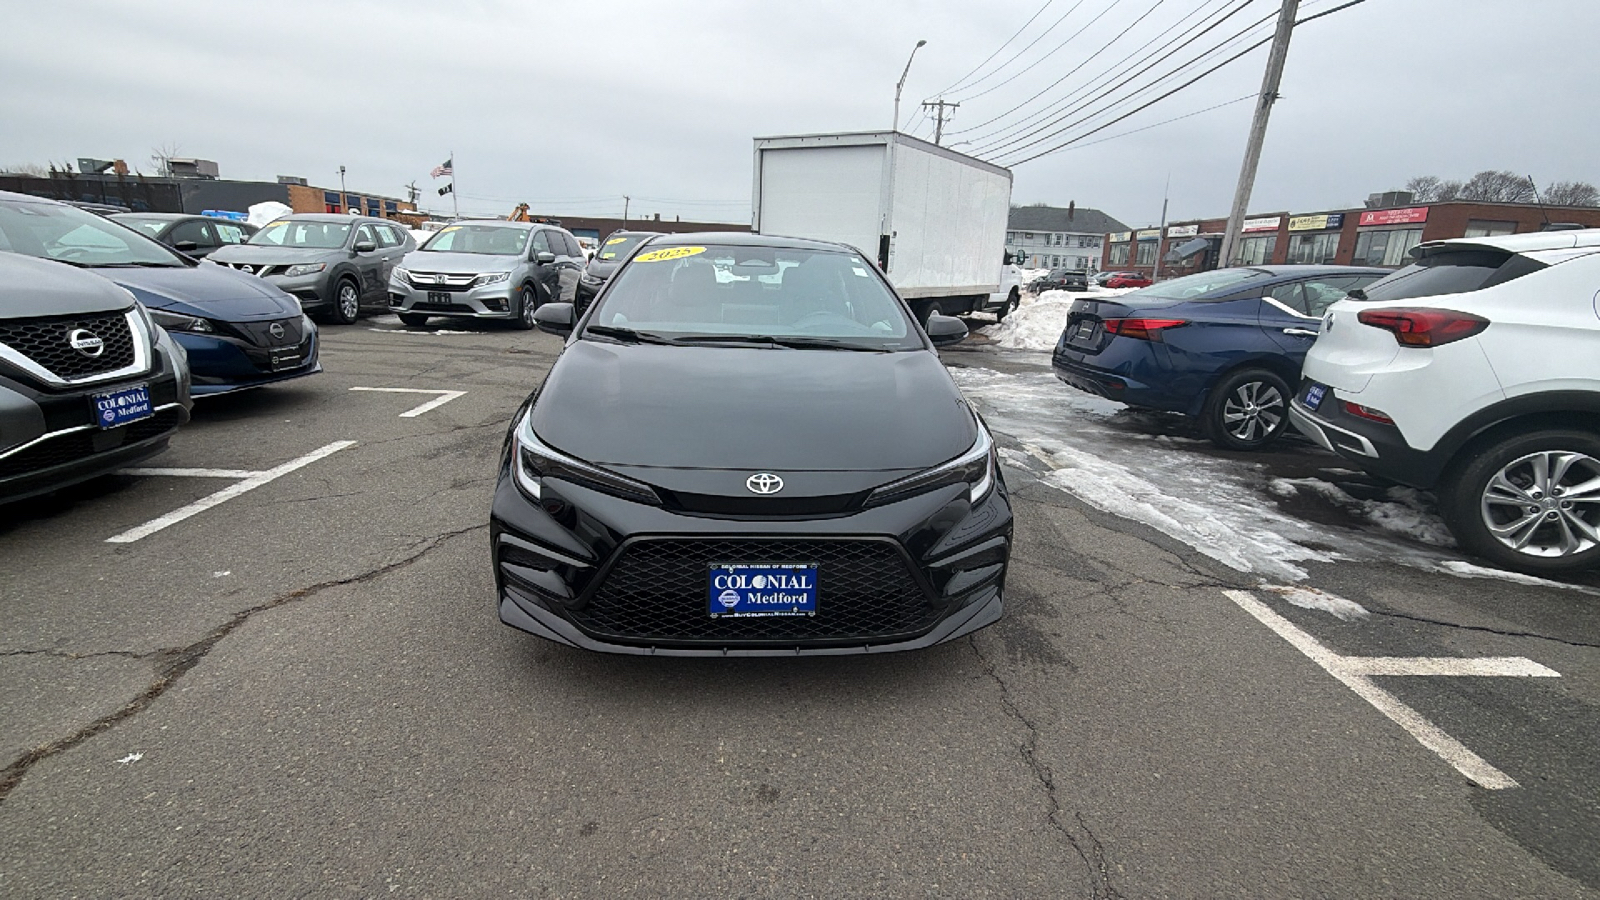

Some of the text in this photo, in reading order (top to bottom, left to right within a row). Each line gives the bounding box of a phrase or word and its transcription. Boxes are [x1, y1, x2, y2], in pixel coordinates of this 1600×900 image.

[647, 248, 691, 260] 2025
[98, 392, 148, 410] COLONIAL
[118, 403, 148, 416] Medford
[714, 575, 813, 589] COLONIAL
[747, 592, 808, 604] Medford
